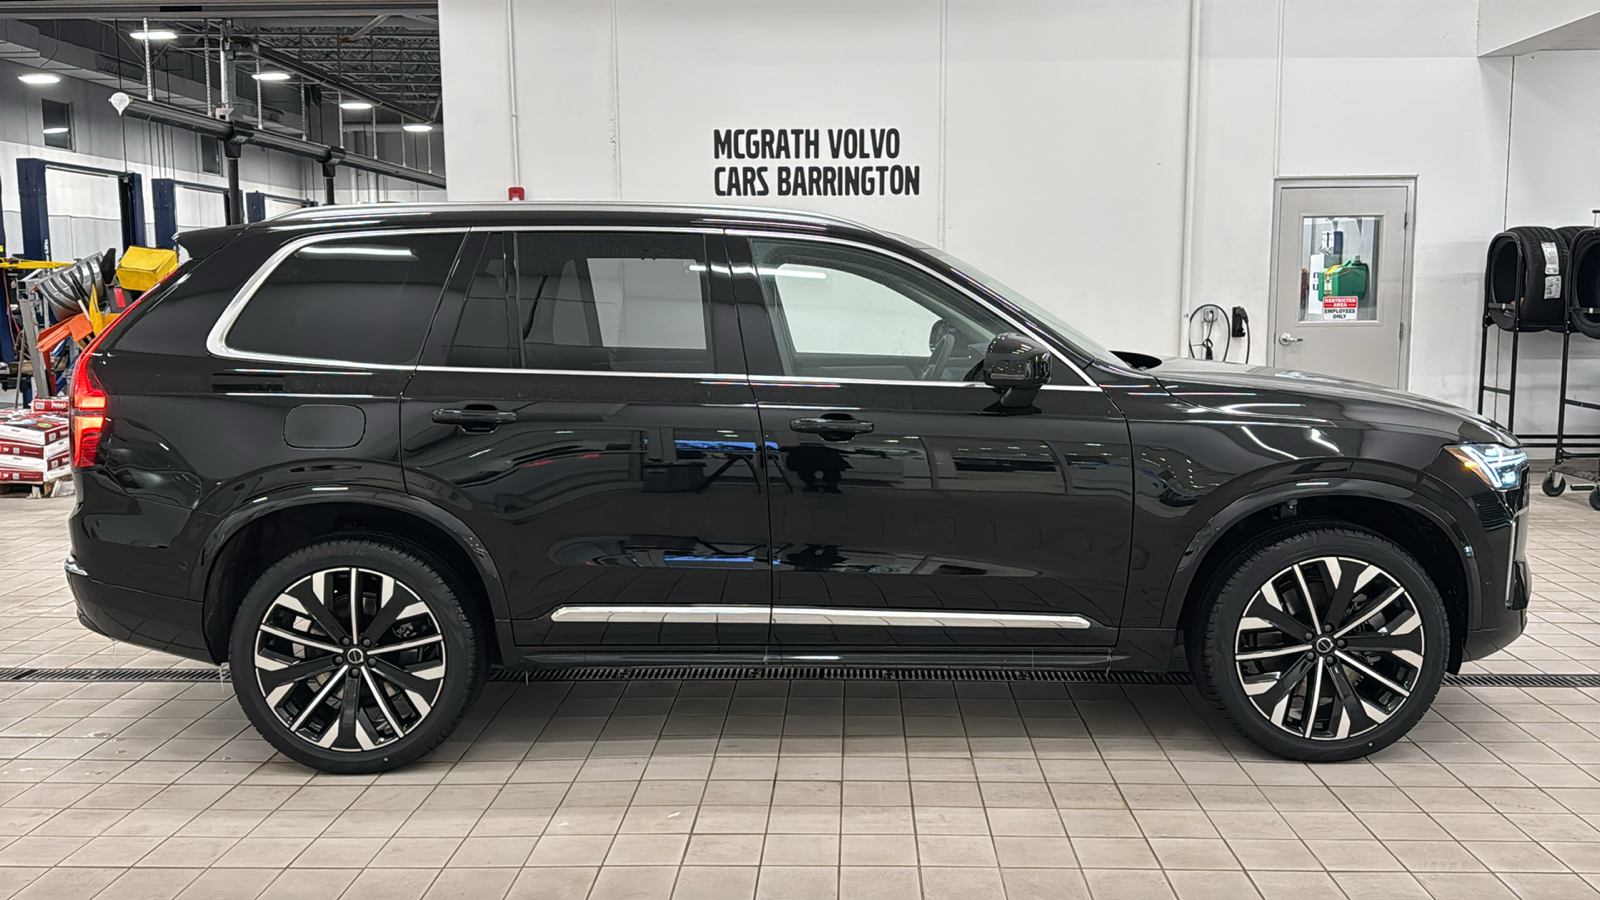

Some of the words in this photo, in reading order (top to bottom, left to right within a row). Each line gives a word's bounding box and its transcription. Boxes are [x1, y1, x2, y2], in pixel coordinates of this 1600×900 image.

[713, 129, 819, 159] MCGRATH
[828, 128, 900, 159] VOLVO
[714, 166, 769, 196] CARS
[777, 165, 920, 196] BARRINGTON
